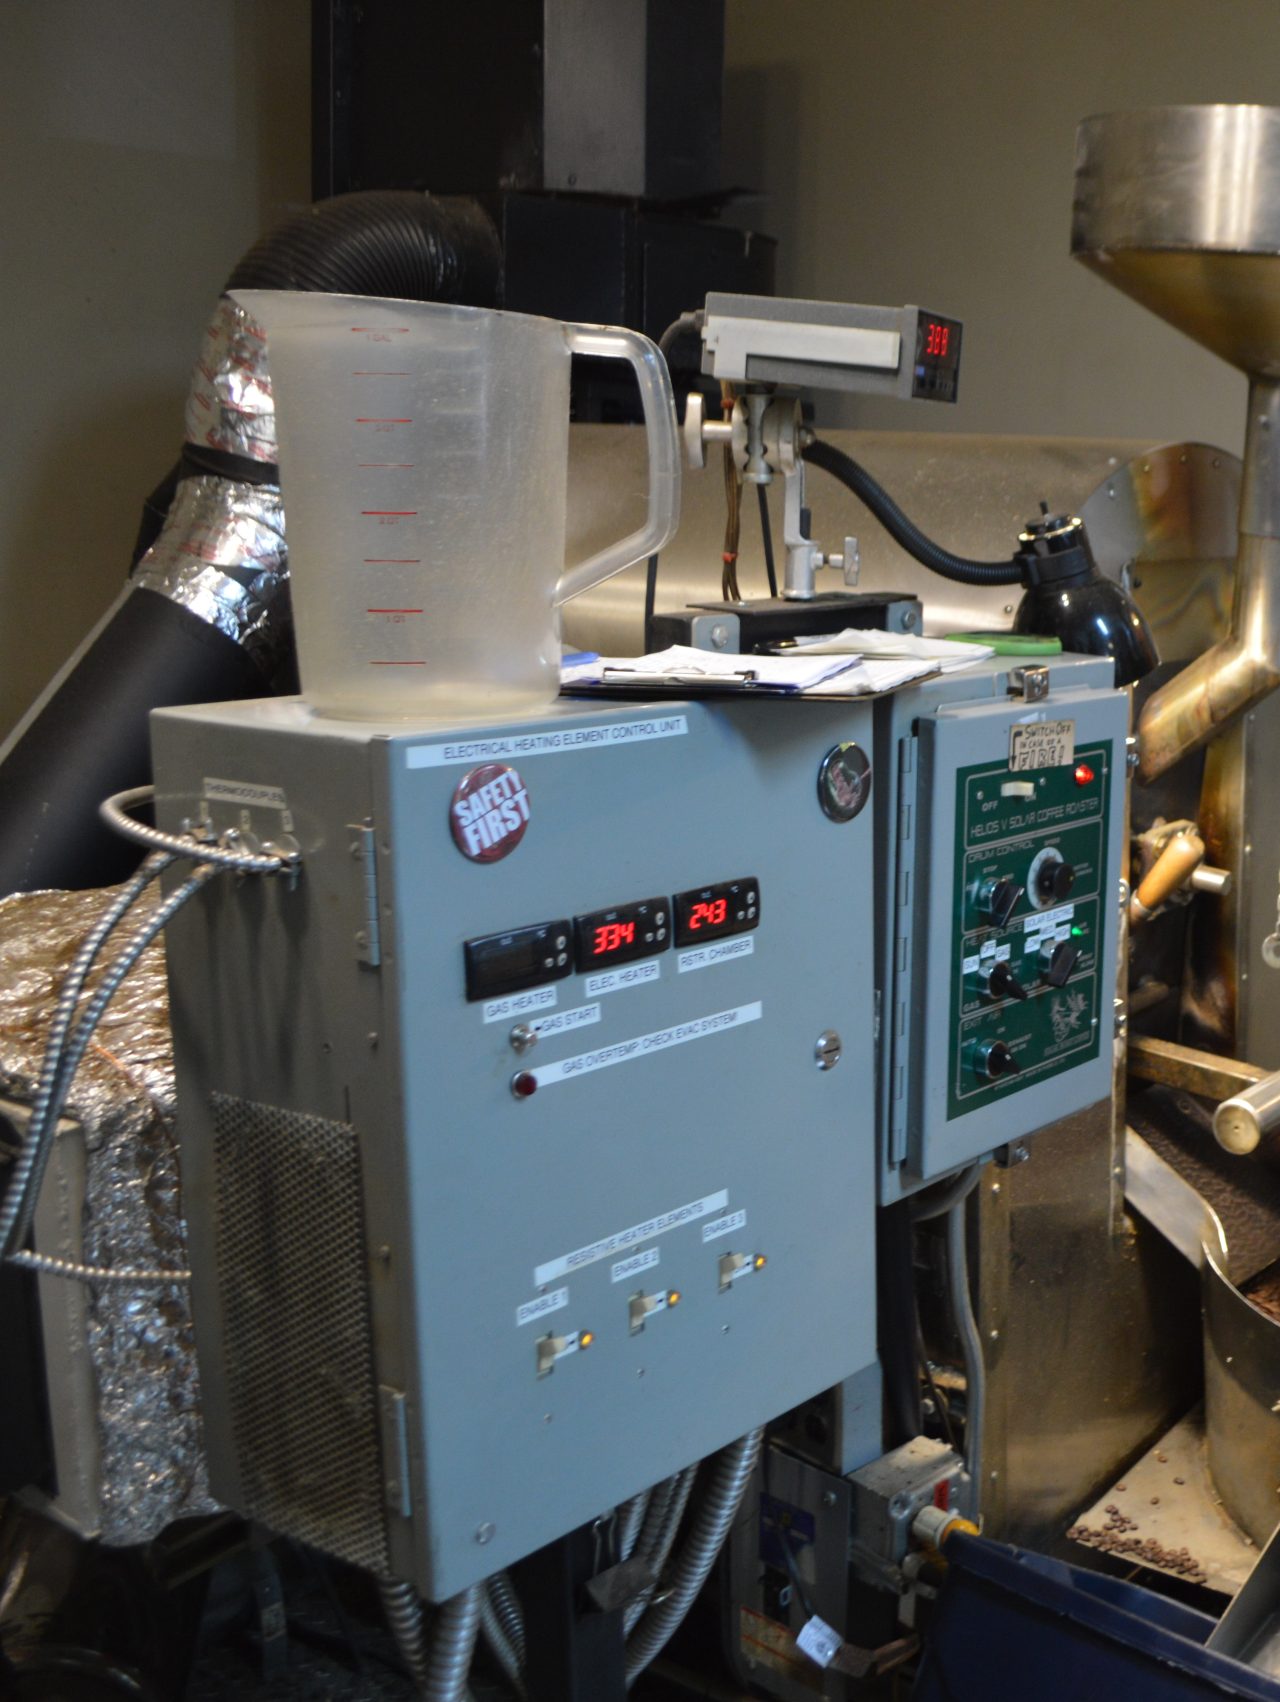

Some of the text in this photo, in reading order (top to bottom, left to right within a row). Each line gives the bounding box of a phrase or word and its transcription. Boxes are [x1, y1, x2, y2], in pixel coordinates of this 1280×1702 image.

[443, 719, 683, 760] ELECTRICAL HEATING ELEMENT CONTROL UNIT
[1018, 746, 1065, 769] FIRE!
[453, 770, 523, 828] SAFETY
[981, 800, 998, 812] OFF
[461, 788, 531, 858] FIRST
[970, 818, 1000, 839] HELIOS
[1009, 811, 1036, 830] SOLAR
[1036, 805, 1066, 824] COFFEE
[1066, 797, 1099, 816] ROASTER
[968, 840, 1035, 864] DRUM CONTROL
[688, 898, 727, 931] 243
[594, 921, 636, 955] 334
[709, 939, 751, 962] CHAMBER
[618, 963, 658, 984] HEATER
[486, 989, 555, 1019] GAS HEATER
[541, 1006, 598, 1033] GAS START
[561, 1056, 586, 1074] GAS
[642, 1031, 675, 1050] CHECK
[676, 1024, 700, 1042] EVAC
[566, 1202, 704, 1267] RESISTIVE HEATER ELEMENTS
[703, 1217, 735, 1238] ENABLE
[613, 1256, 649, 1278] ENABLE
[519, 1296, 558, 1320] ENABLE
